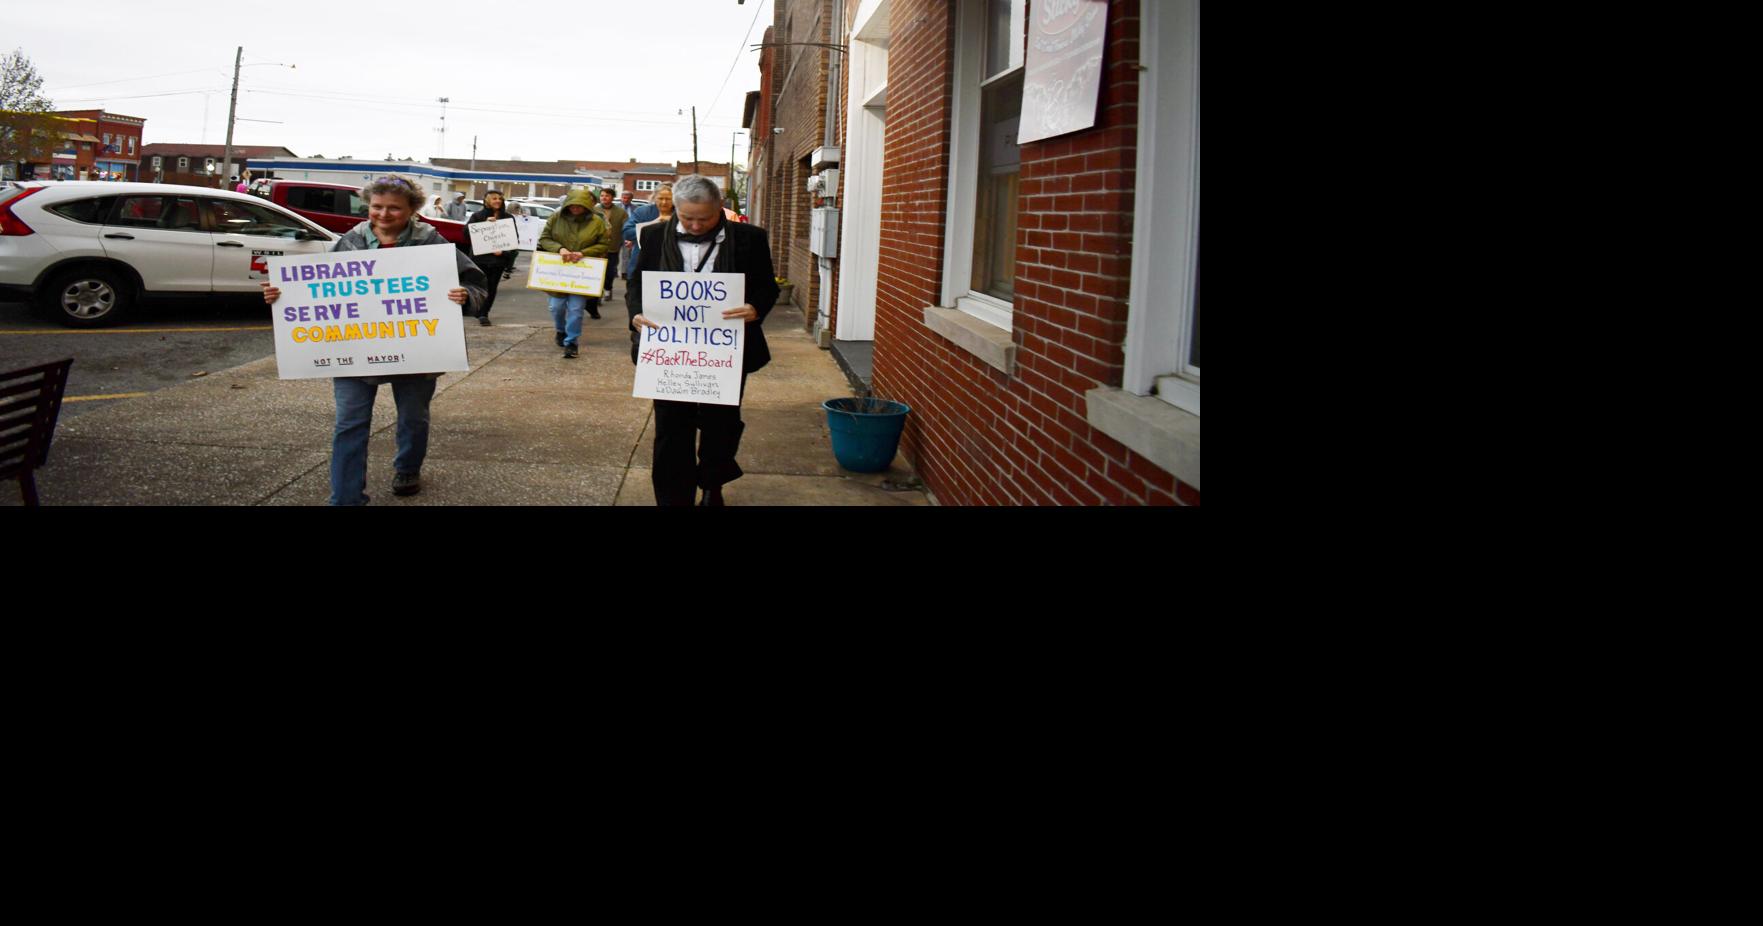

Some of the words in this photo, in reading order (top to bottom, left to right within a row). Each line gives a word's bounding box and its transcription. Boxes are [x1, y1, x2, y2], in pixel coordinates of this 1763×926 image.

[281, 260, 377, 282] LIBRARY
[307, 275, 430, 299] TRUSTEES
[659, 280, 728, 302] BOOKS
[284, 302, 360, 322] SERVE
[382, 297, 429, 316] THE
[674, 305, 712, 323] NOT
[291, 319, 440, 344] COMMUNITY
[647, 326, 738, 350] POLITICS!
[313, 357, 331, 366] NOT
[336, 356, 354, 365] THE
[367, 354, 406, 364] MAYOR!
[641, 348, 733, 369] #BackTheBoard
[663, 369, 692, 380] Rhonda
[693, 370, 717, 380] James
[684, 380, 720, 388] Sullivan
[690, 387, 721, 399] Bradley
